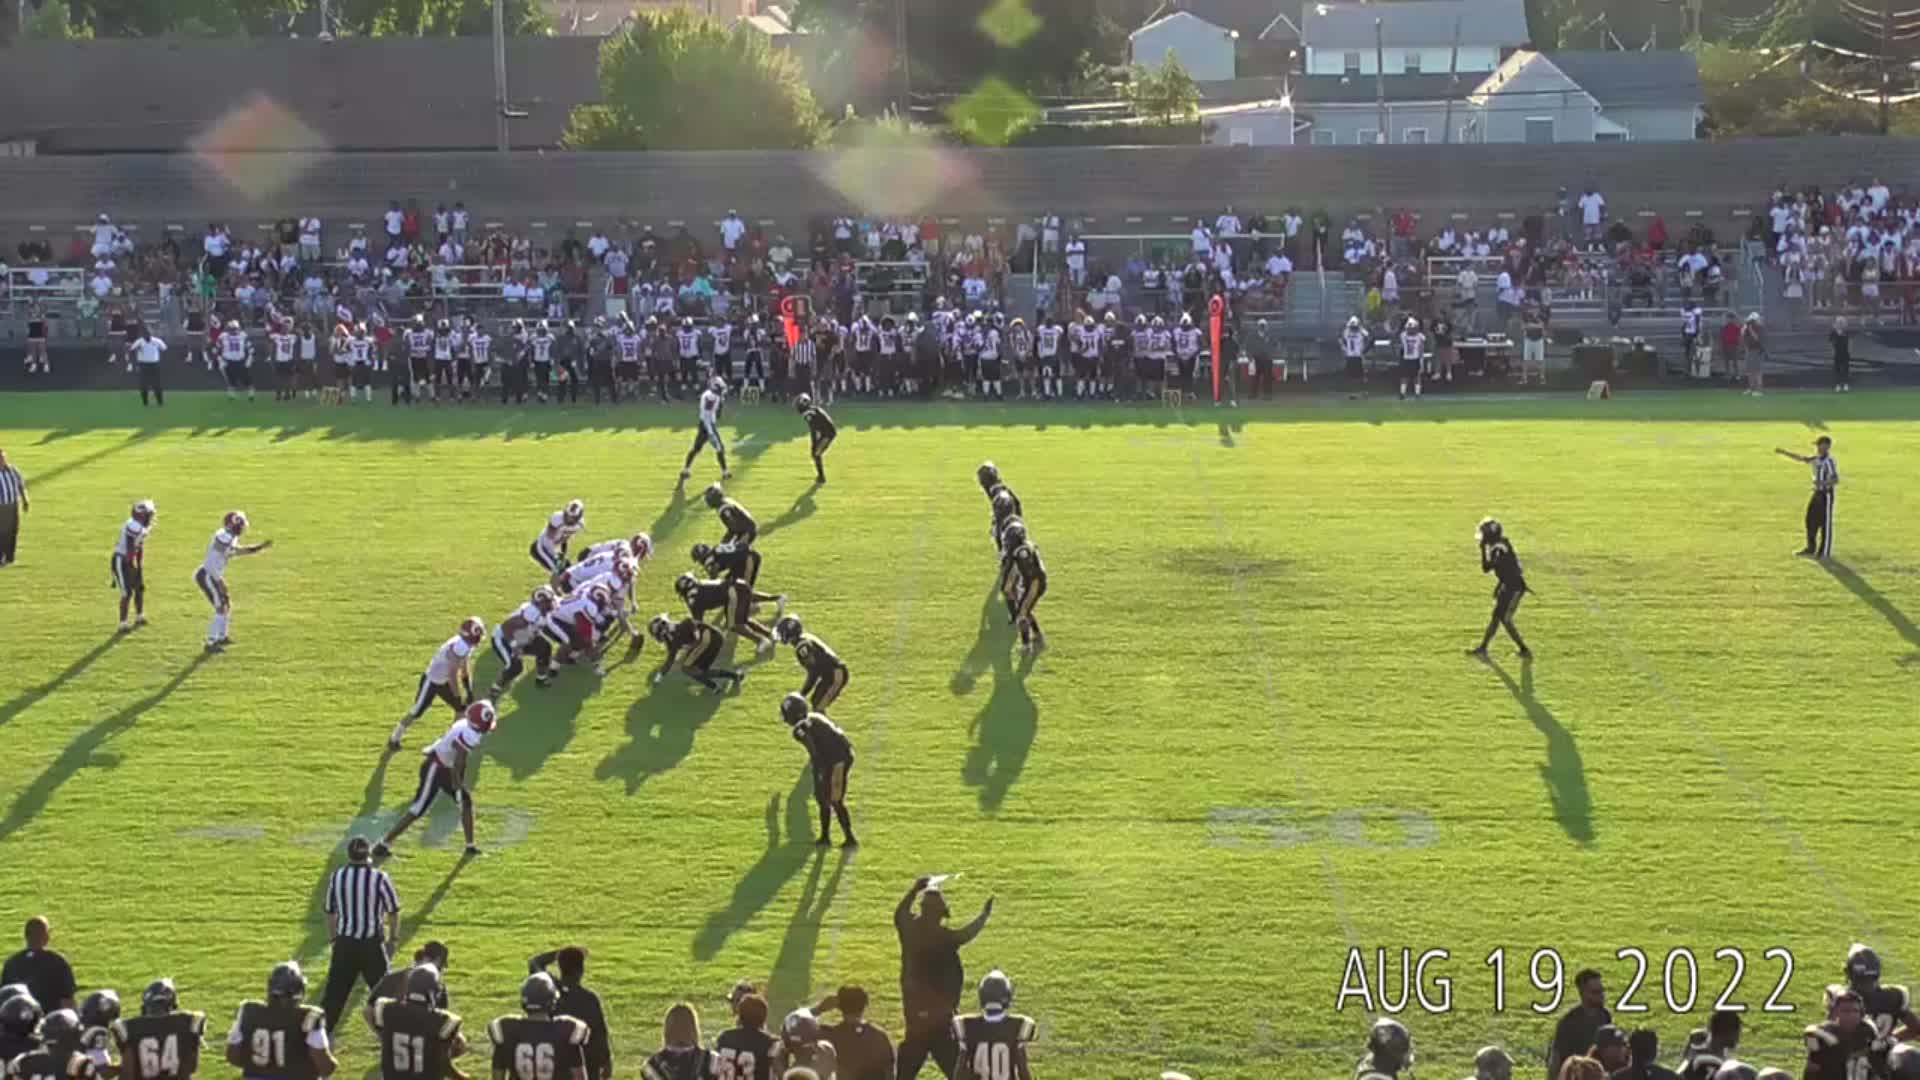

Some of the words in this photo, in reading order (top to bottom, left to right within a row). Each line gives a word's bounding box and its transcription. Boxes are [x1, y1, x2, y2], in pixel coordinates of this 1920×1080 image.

[138, 1034, 179, 1078] 64
[251, 1028, 285, 1067] 91
[391, 1032, 424, 1073] 51
[515, 1042, 555, 1080] 66
[973, 1041, 1011, 1080] 40
